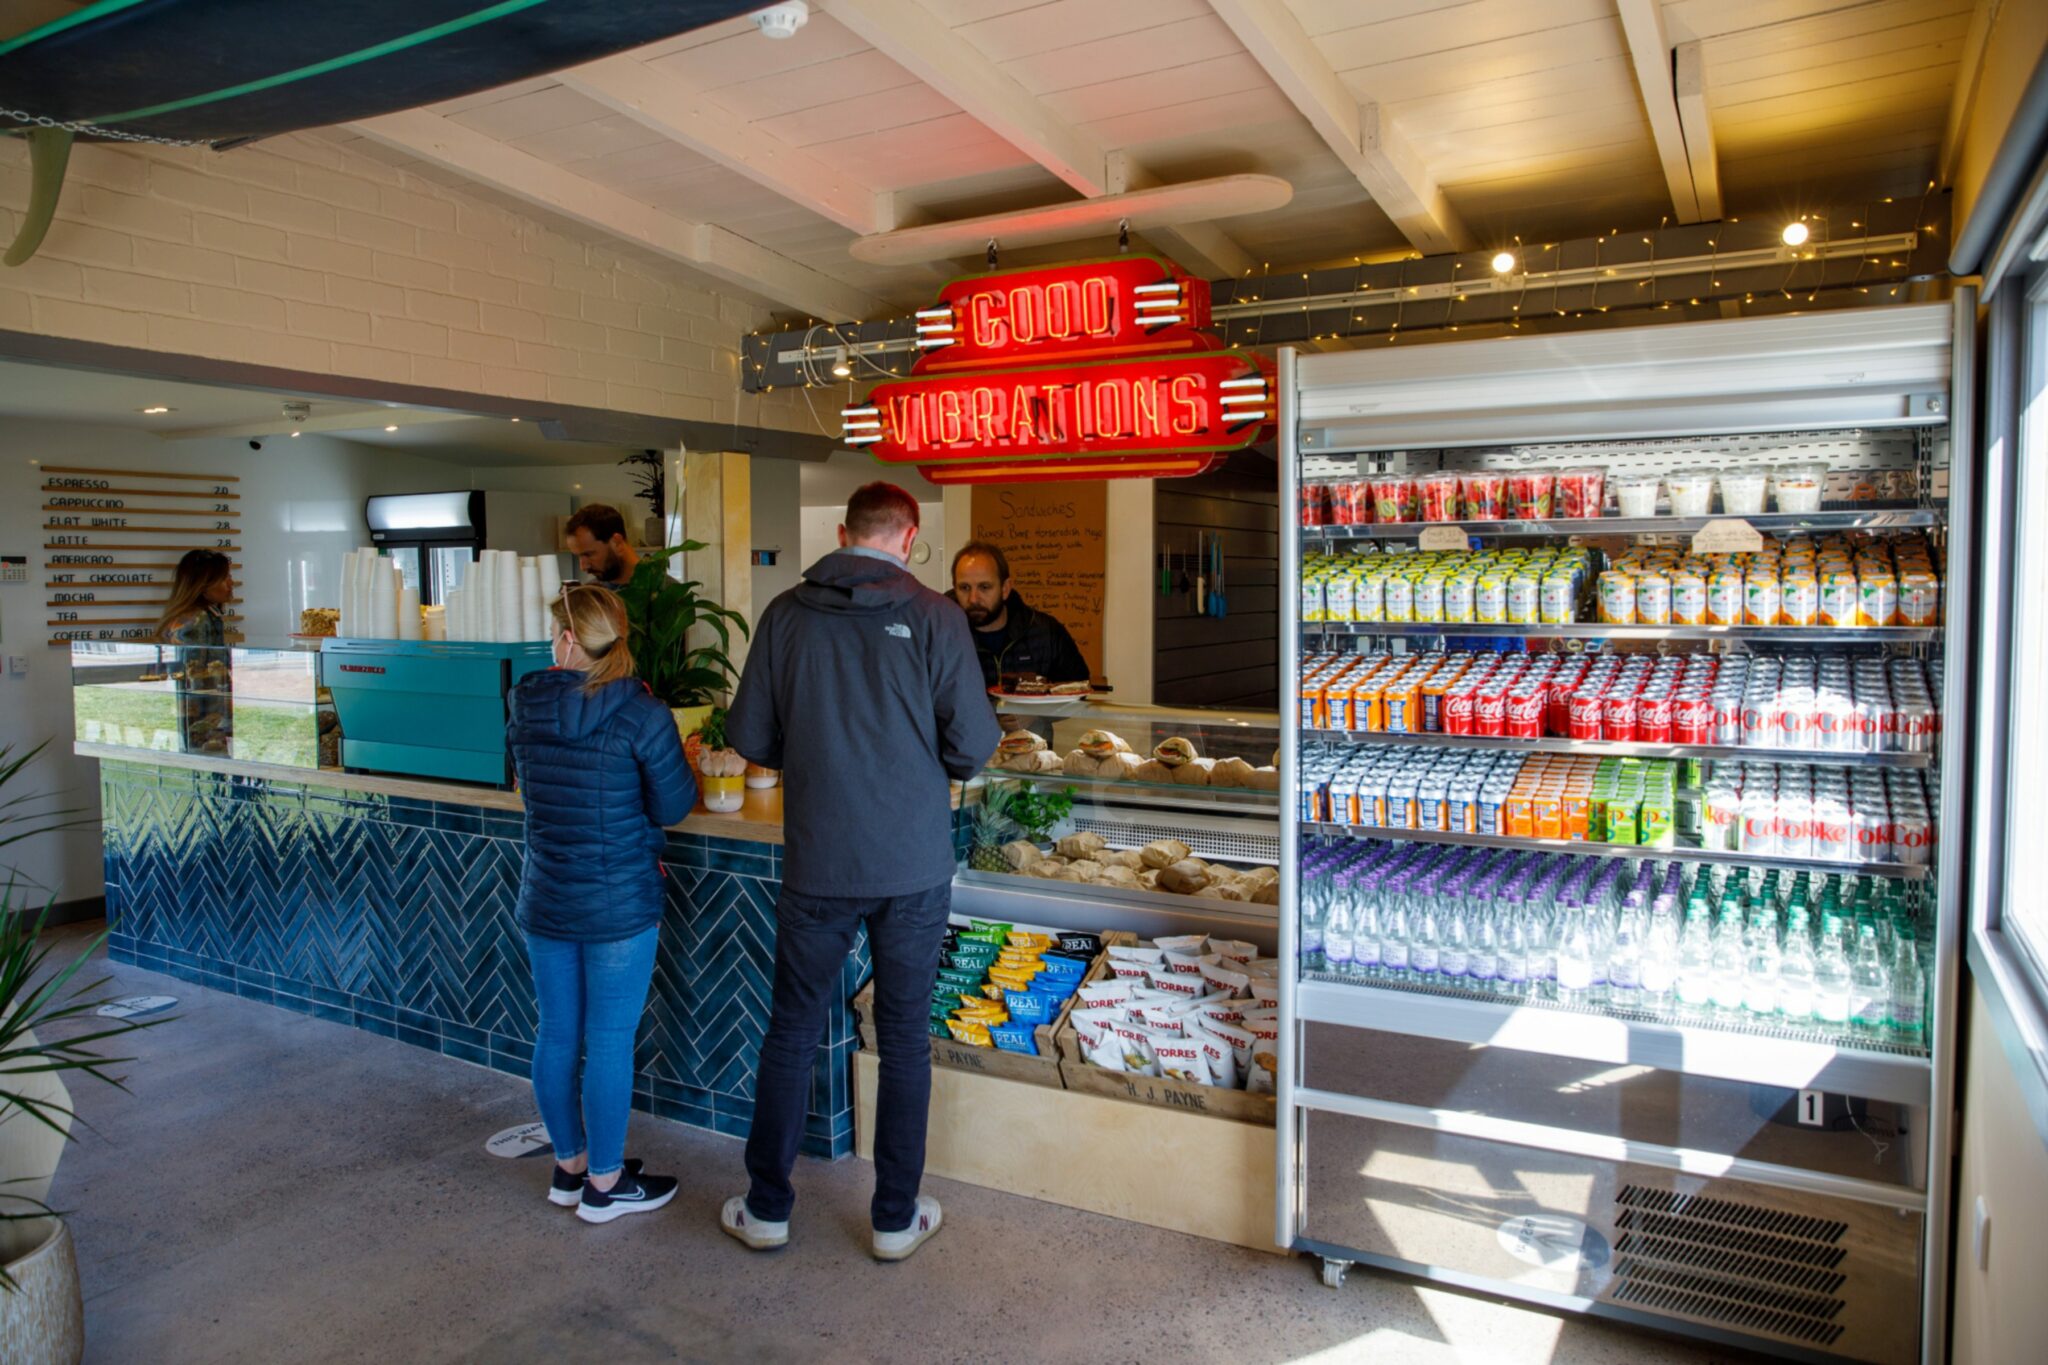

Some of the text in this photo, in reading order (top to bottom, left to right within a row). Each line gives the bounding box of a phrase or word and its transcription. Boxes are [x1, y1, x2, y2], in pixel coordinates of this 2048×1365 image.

[889, 373, 1208, 450] VIBRATIONS
[48, 478, 228, 495] ESPRESSO 2.0
[49, 497, 229, 512] CAPPUCCINO 2.8
[50, 516, 230, 530] FLAT WHITE 2.8
[51, 536, 231, 547] LATTE 2.8
[52, 554, 113, 564] AMERICANO
[53, 574, 153, 583] HOT CHOCOLATE
[54, 593, 95, 602] MOCHA
[56, 612, 78, 620] TEA
[53, 631, 93, 640] COFFEE
[99, 629, 114, 639] BY
[954, 958, 984, 969] REAL
[1173, 963, 1200, 974] TORR
[1155, 980, 1196, 994] TORRES
[1009, 997, 1041, 1009] REAL
[995, 1033, 1026, 1046] REAL
[1155, 1047, 1197, 1059] TORRES
[1203, 1044, 1221, 1060] RES
[1164, 1088, 1208, 1110] PAYNE
[1806, 1094, 1815, 1121] 1
[735, 1211, 744, 1226] N
[918, 1215, 929, 1231] N
